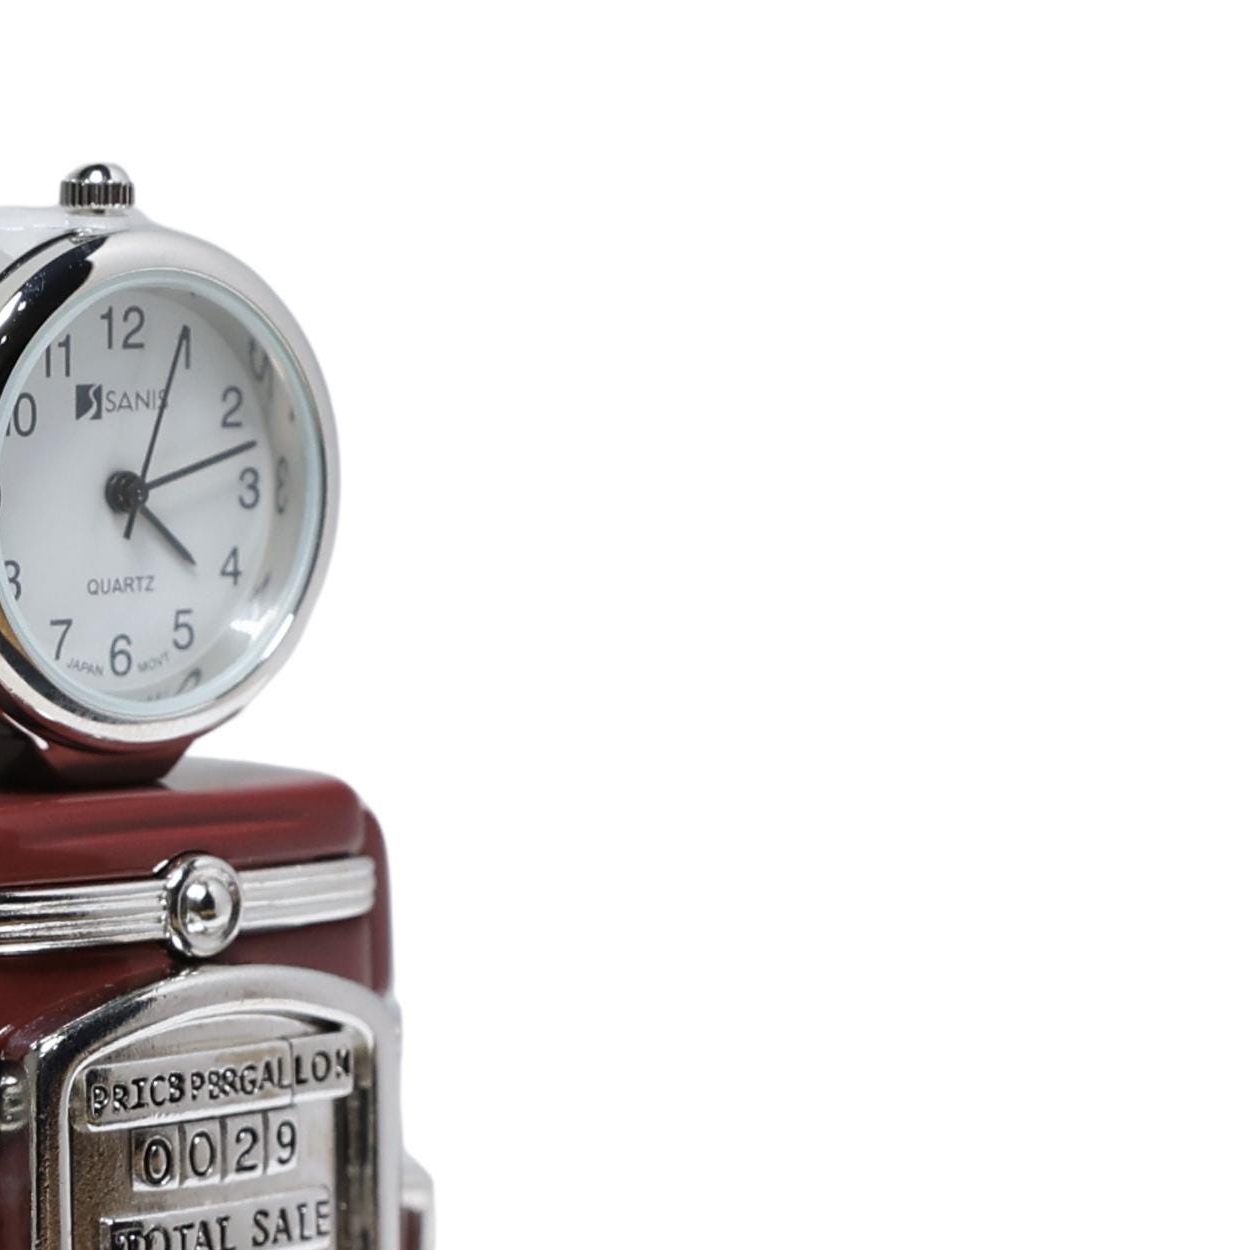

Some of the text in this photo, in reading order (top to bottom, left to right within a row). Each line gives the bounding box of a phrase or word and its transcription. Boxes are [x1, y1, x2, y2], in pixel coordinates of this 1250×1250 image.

[100, 306, 145, 349] 12
[105, 388, 169, 413] SANIS
[221, 386, 243, 428] 2
[239, 467, 260, 509] 3
[87, 576, 155, 596] QUARTZ
[220, 546, 241, 586] 4
[50, 618, 73, 660] 7
[172, 609, 195, 650] 5
[67, 658, 104, 676] JAPAN
[109, 634, 132, 677] 6
[143, 1120, 297, 1186] 0029
[252, 1201, 331, 1247] SALE
